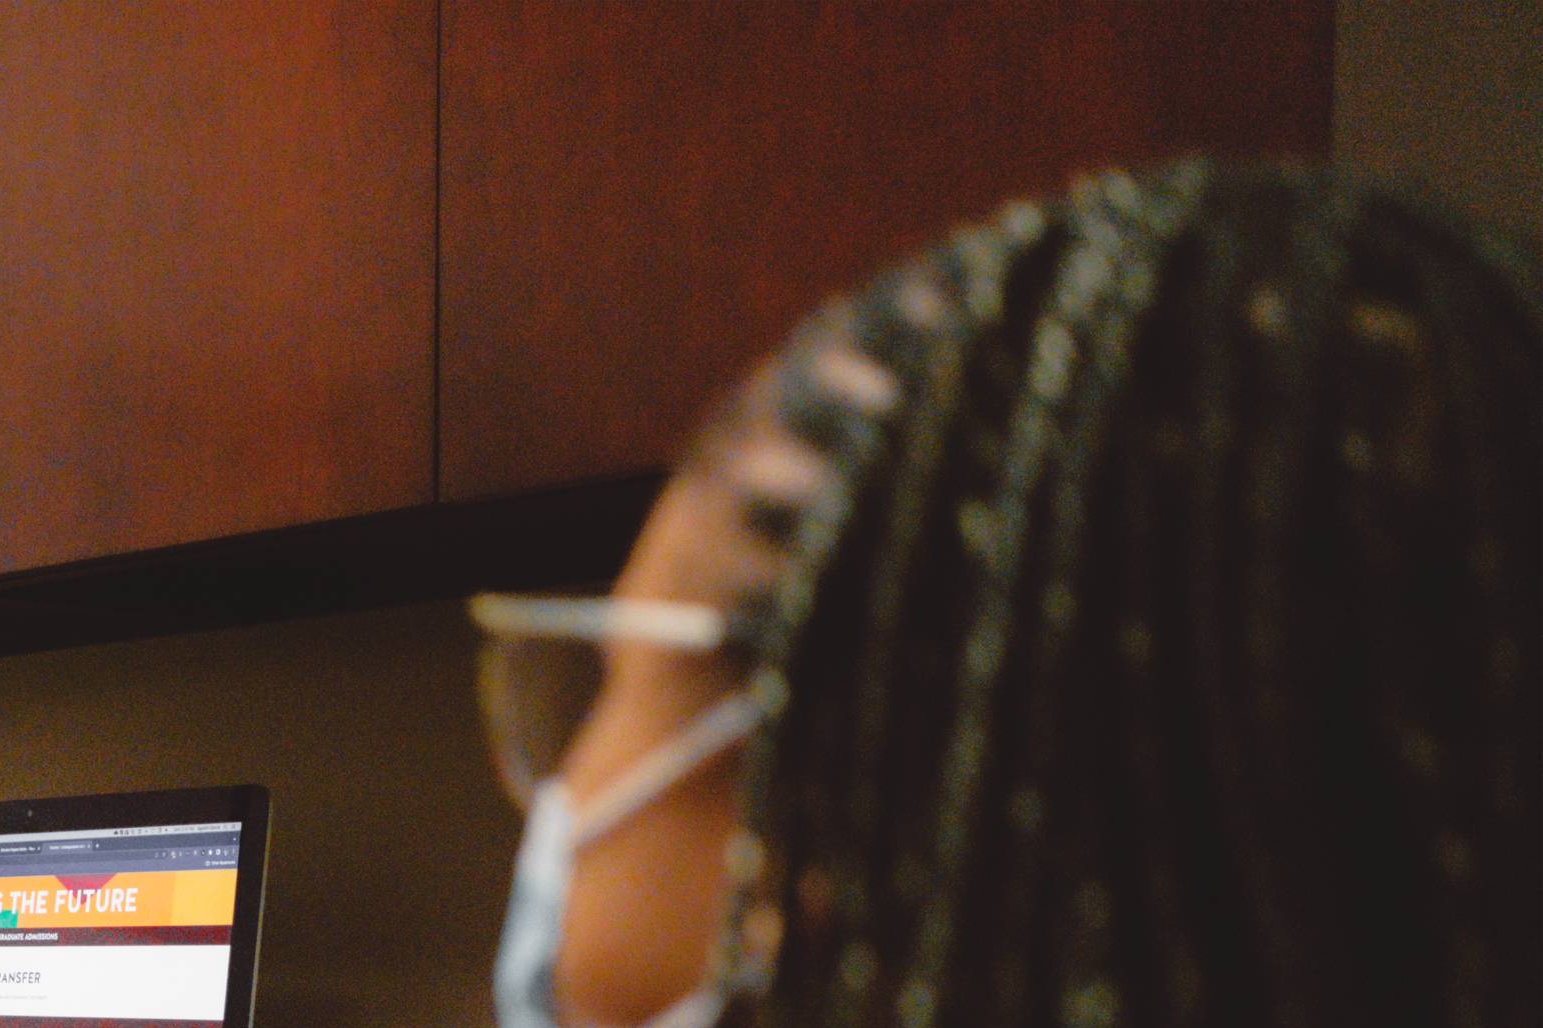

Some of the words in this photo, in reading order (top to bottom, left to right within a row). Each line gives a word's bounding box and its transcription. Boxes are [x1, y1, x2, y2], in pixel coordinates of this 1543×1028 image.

[9, 889, 49, 915] THE
[54, 887, 139, 914] FUTURE
[24, 932, 59, 941] ADMISSIONS
